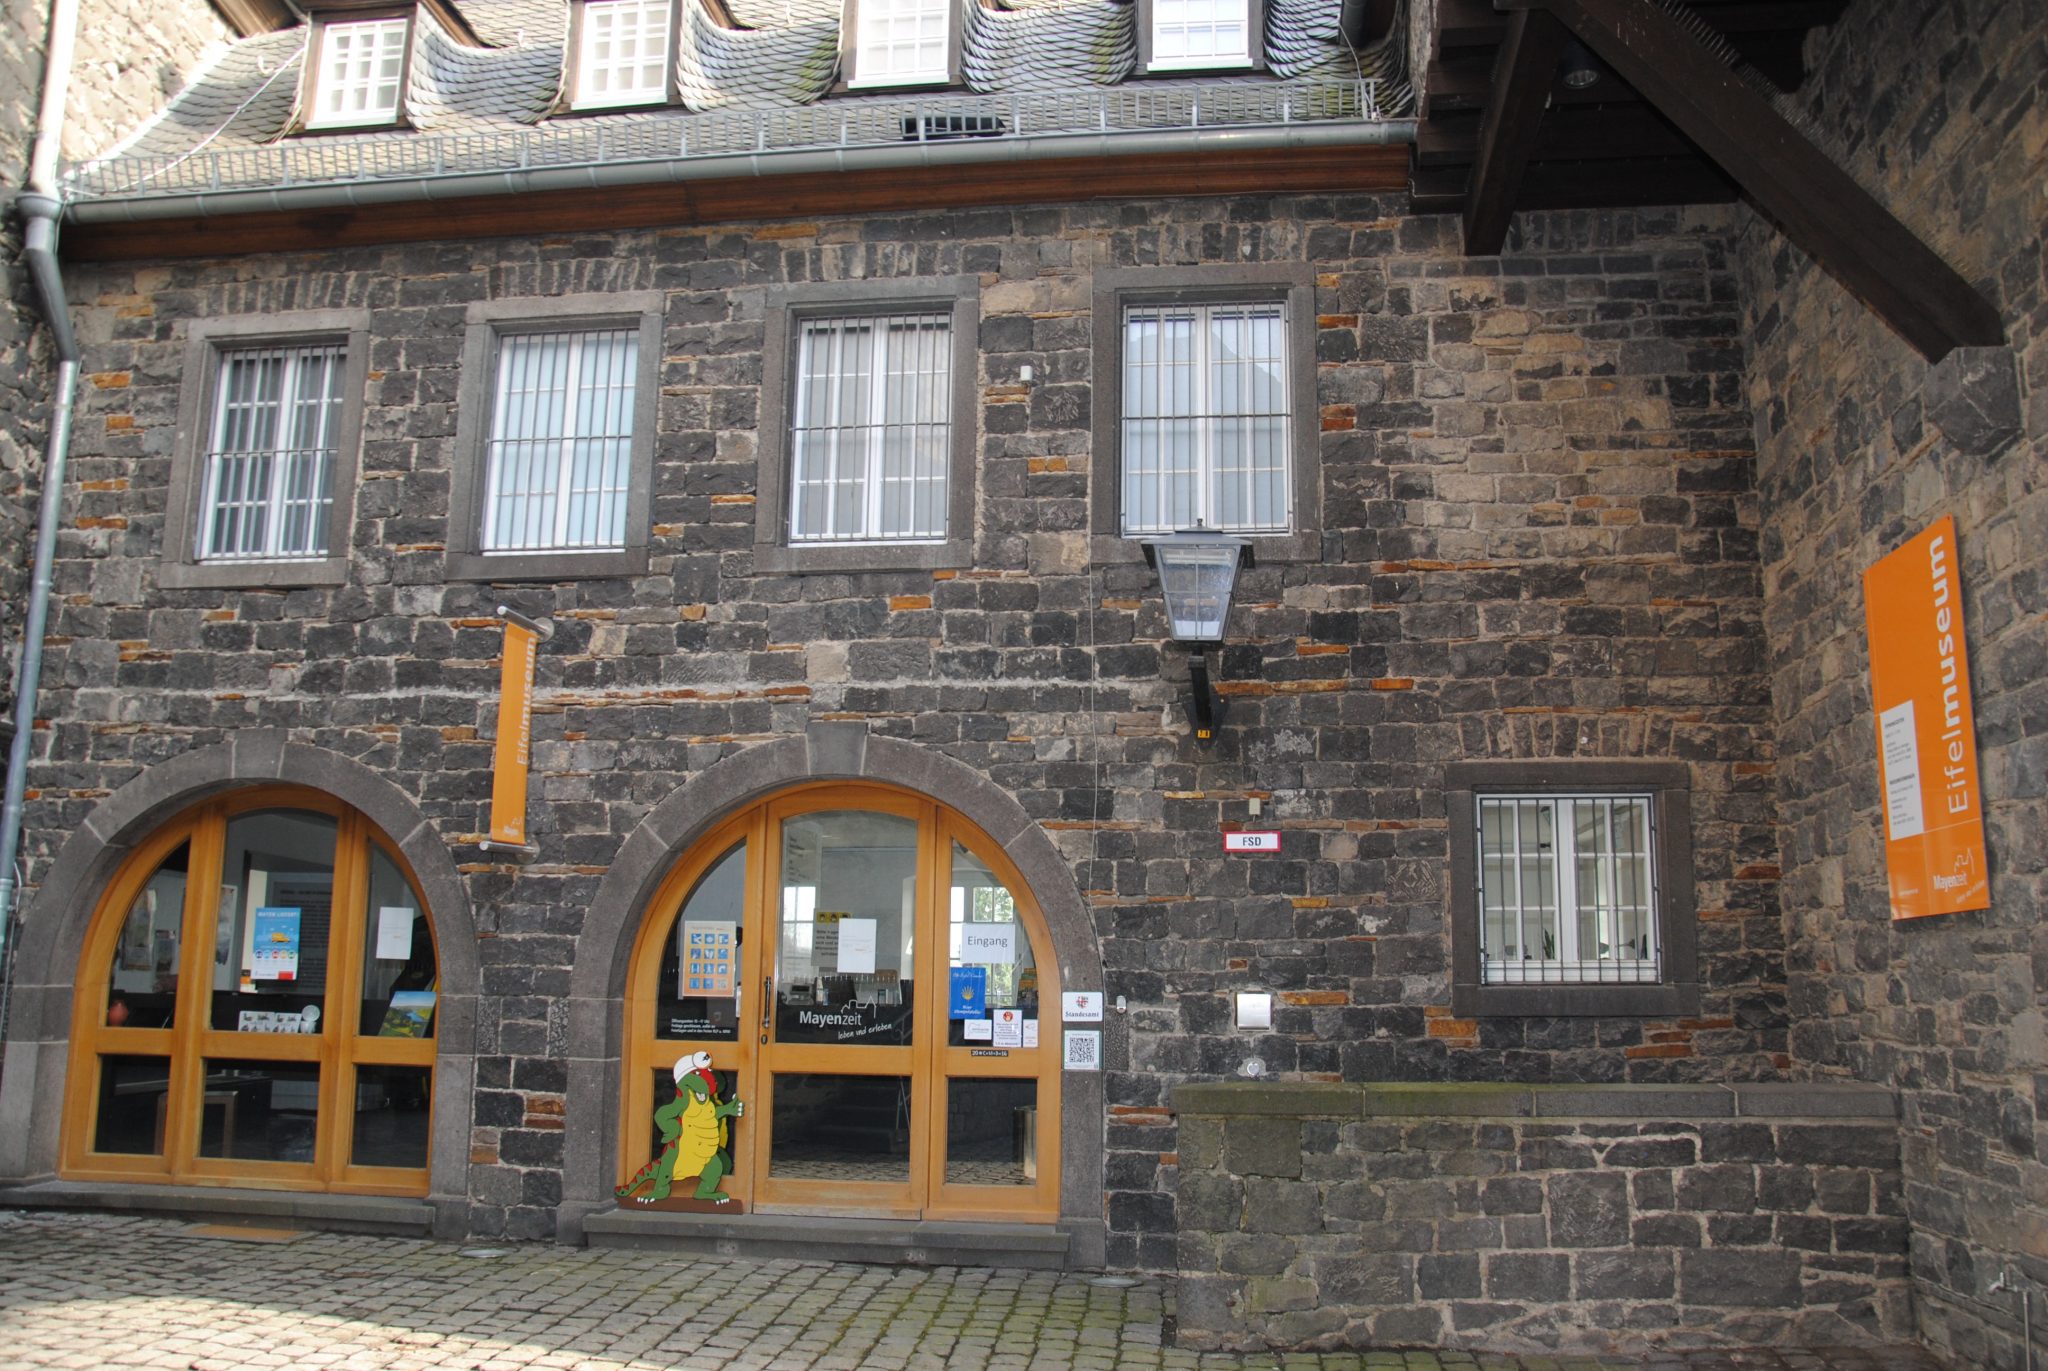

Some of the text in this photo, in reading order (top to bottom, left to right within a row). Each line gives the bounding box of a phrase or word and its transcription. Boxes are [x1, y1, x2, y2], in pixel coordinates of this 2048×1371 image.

[1927, 534, 1969, 814] Eifelmuseum
[516, 636, 537, 766] Eifelmuseum
[1242, 836, 1262, 847] FSD
[967, 935, 1008, 948] Eingang
[799, 1010, 862, 1029] Mayenzeit
[837, 1022, 893, 1041] leben und erleben
